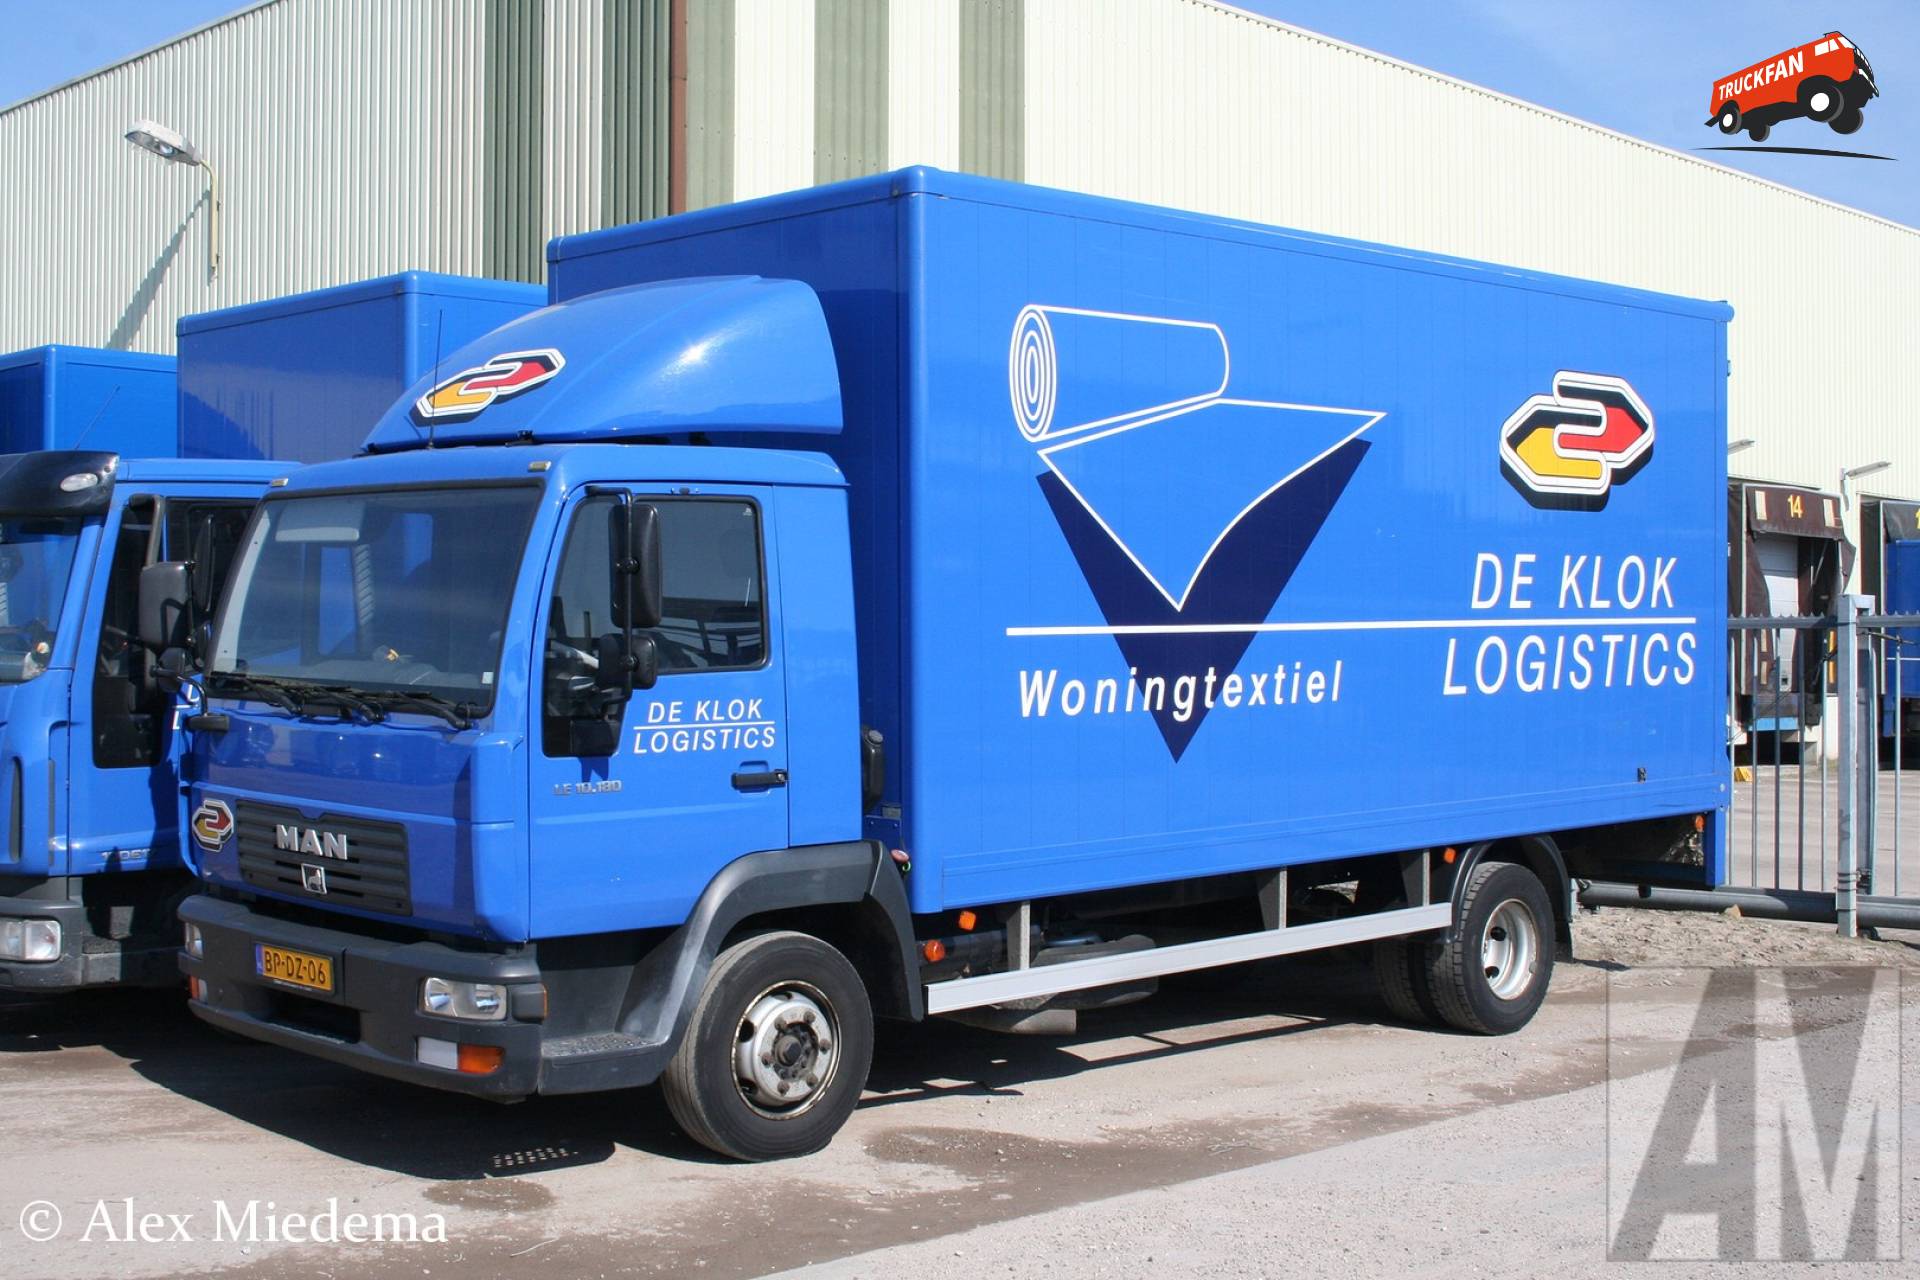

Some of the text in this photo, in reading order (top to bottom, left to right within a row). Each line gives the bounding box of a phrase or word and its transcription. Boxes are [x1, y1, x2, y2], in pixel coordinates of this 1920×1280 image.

[1788, 495, 1803, 518] 14
[1471, 552, 1677, 609] DE KLOK
[1443, 632, 1696, 695] LOGISTICS
[1019, 660, 1343, 722] Woningtextiel
[648, 699, 763, 723] DE KLOK
[633, 727, 775, 754] LOGISTICS
[276, 824, 347, 860] MAN
[264, 950, 326, 985] BP-DZ-06
